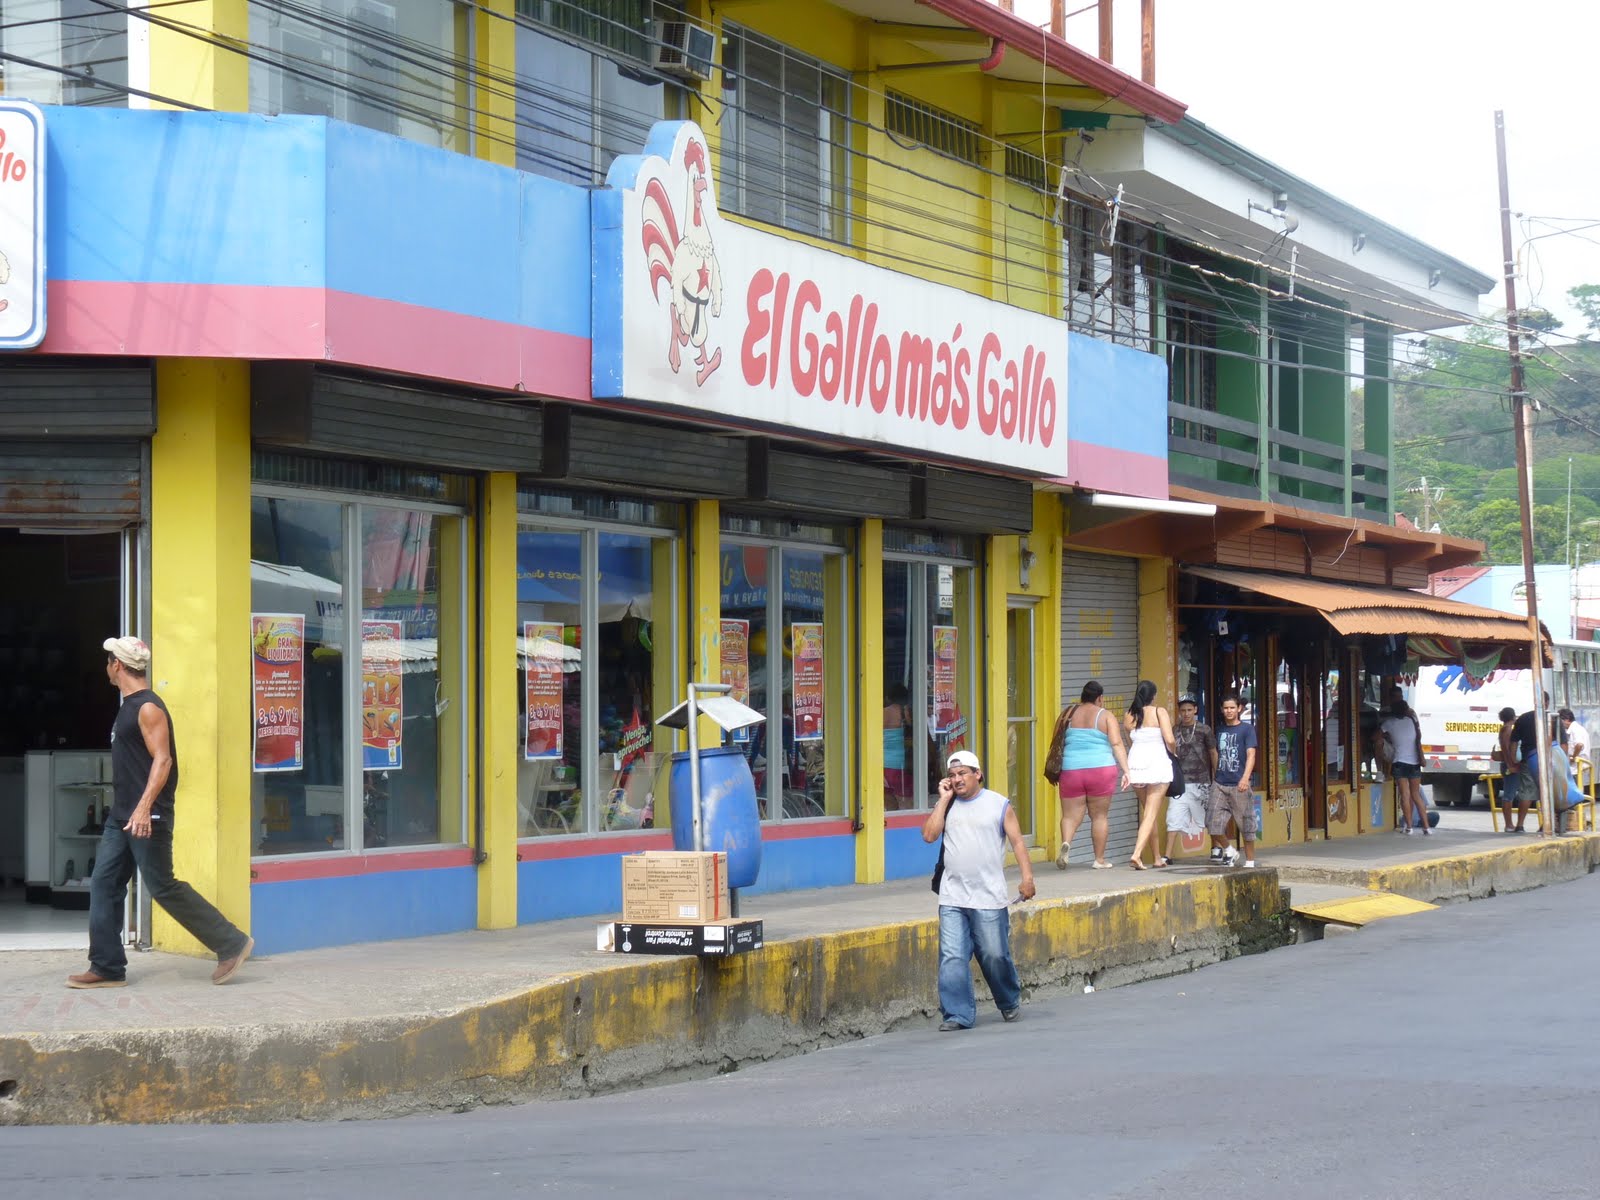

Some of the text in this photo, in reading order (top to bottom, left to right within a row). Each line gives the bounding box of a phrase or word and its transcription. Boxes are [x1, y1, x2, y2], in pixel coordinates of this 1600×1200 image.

[0, 151, 26, 184] lo
[741, 268, 1057, 448] El Gallo más Gallo
[1445, 722, 1504, 734] SERVICIOS ESPECI
[617, 731, 652, 760] aproveche!
[645, 930, 665, 938] Control
[645, 936, 657, 945] Fan
[657, 937, 681, 945] Pedestal
